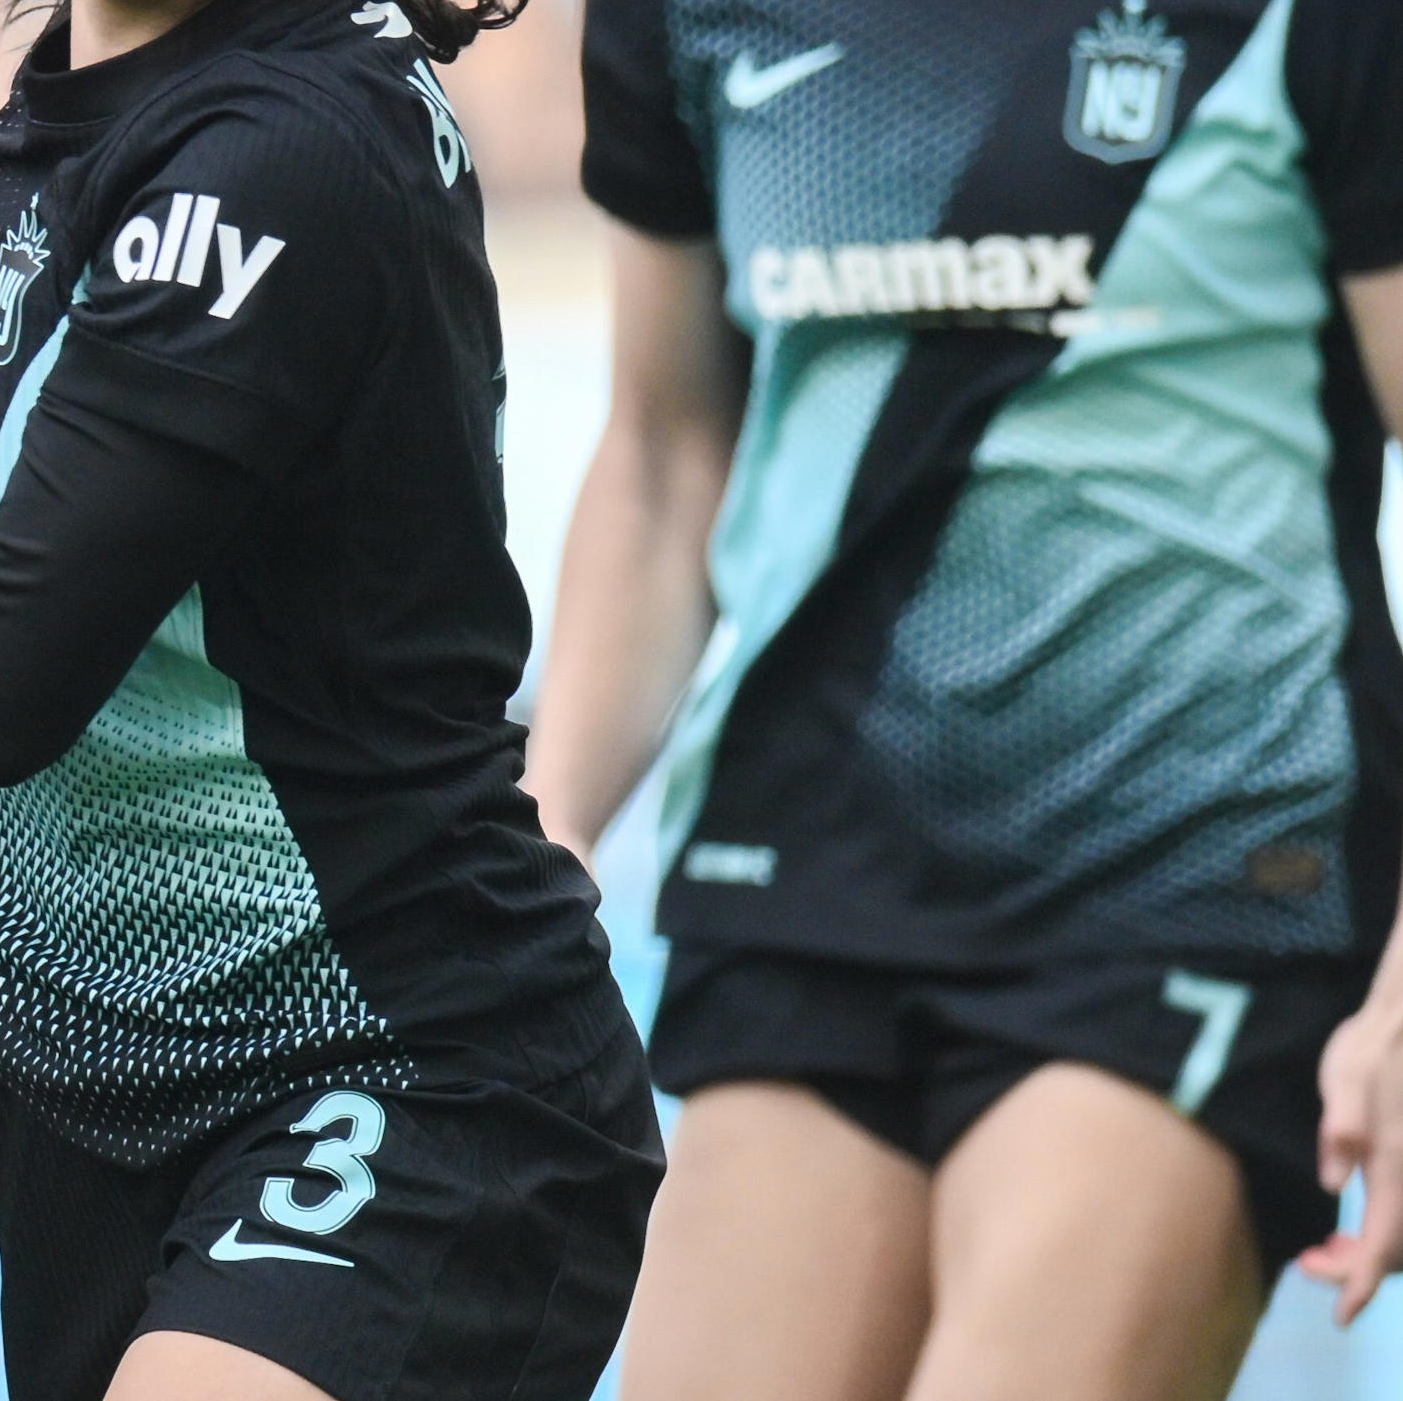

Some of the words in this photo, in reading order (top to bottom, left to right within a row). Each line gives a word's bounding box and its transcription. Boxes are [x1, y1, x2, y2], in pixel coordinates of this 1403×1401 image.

[113, 193, 286, 319] ally
[1161, 968, 1251, 1117] 7
[259, 1090, 386, 1236] 3
